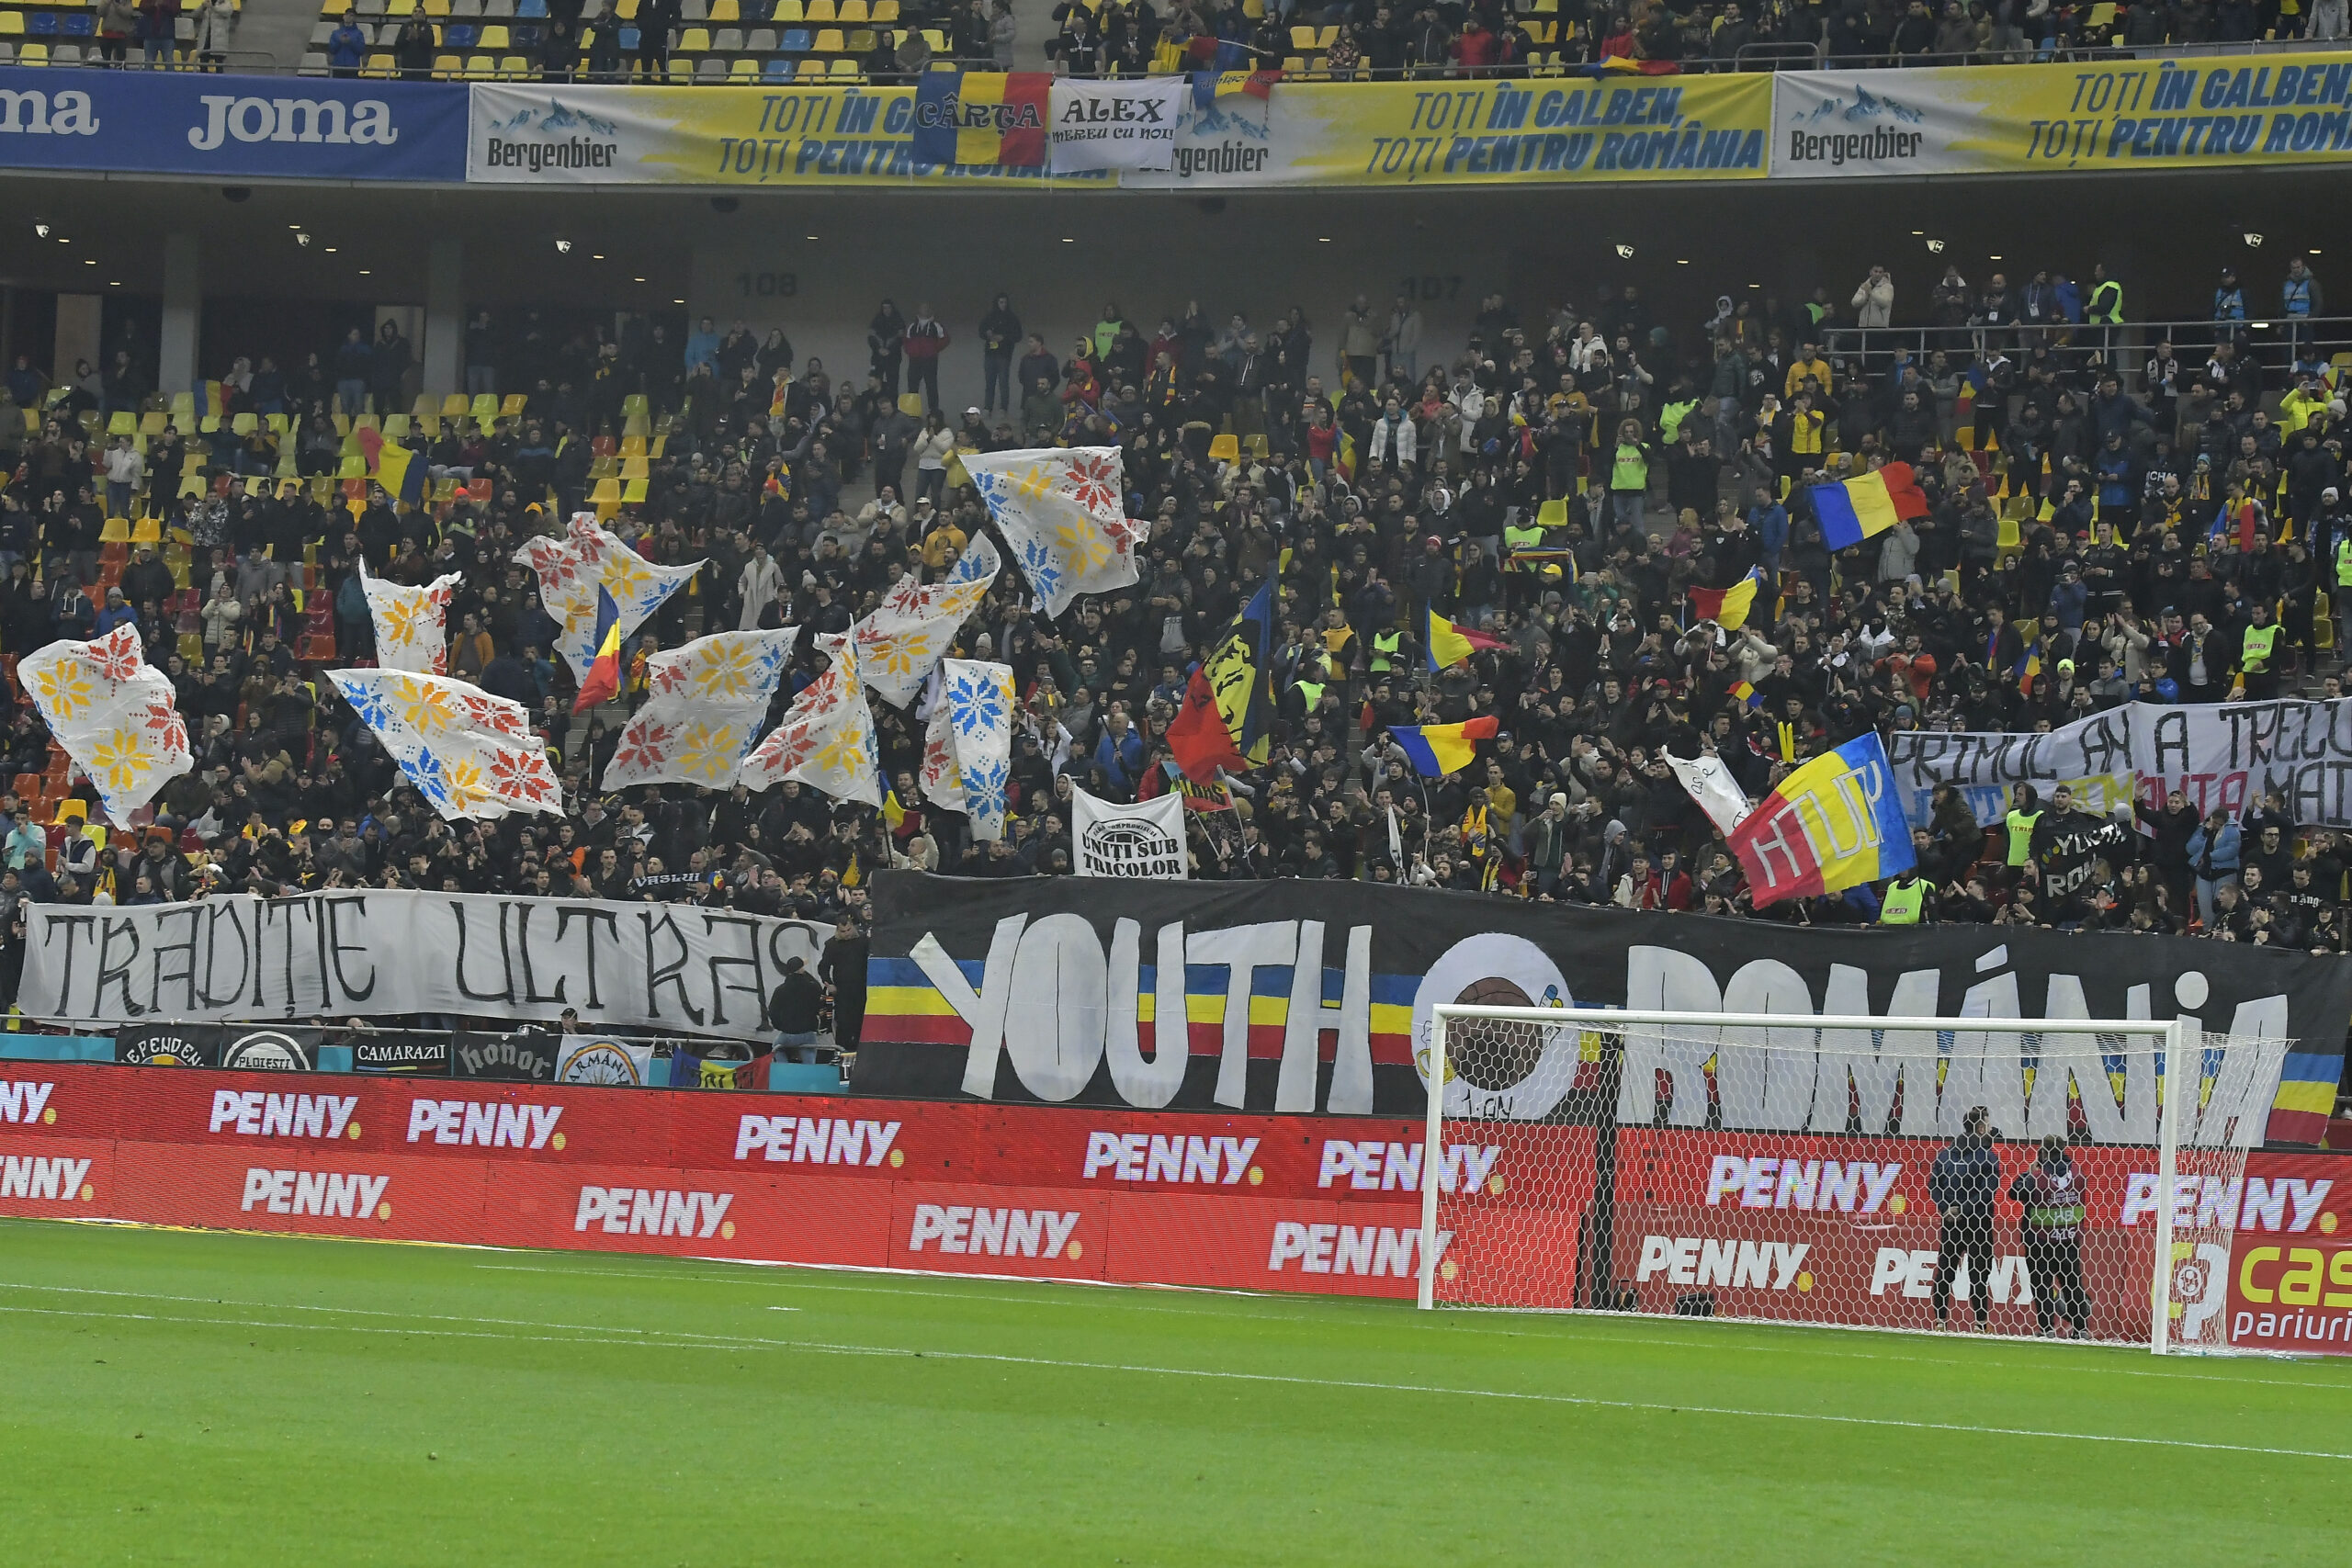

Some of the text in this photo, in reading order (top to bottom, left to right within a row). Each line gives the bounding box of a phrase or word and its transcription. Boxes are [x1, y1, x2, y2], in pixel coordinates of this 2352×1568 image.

[1487, 81, 1532, 130] ÎN
[1534, 87, 1683, 130] GALBEN,
[2150, 61, 2199, 111] ÎN
[0, 89, 99, 135] ma
[834, 88, 880, 135] ÎN
[1061, 98, 1166, 124] ALEX
[1442, 132, 1596, 174] PENTRU
[1594, 120, 1765, 173] ROMÂNIA
[1791, 125, 1923, 165] Bergenbier
[2107, 115, 2265, 159] PENTRU
[2262, 111, 2352, 153] ROM
[488, 136, 616, 174] Bergenbier
[796, 140, 928, 176] PENTR
[1159, 140, 1269, 178] rgenbier
[736, 273, 797, 297] 108
[1889, 735, 2057, 786] PRIMUL
[2080, 710, 2132, 776] AN
[2154, 711, 2188, 773] A
[1083, 852, 1182, 877] TRICOLOR
[1137, 838, 1179, 858] SUB
[634, 872, 700, 887] VASLUI
[909, 912, 1374, 1116] YOUTH
[2051, 1227, 2076, 1241] 416
